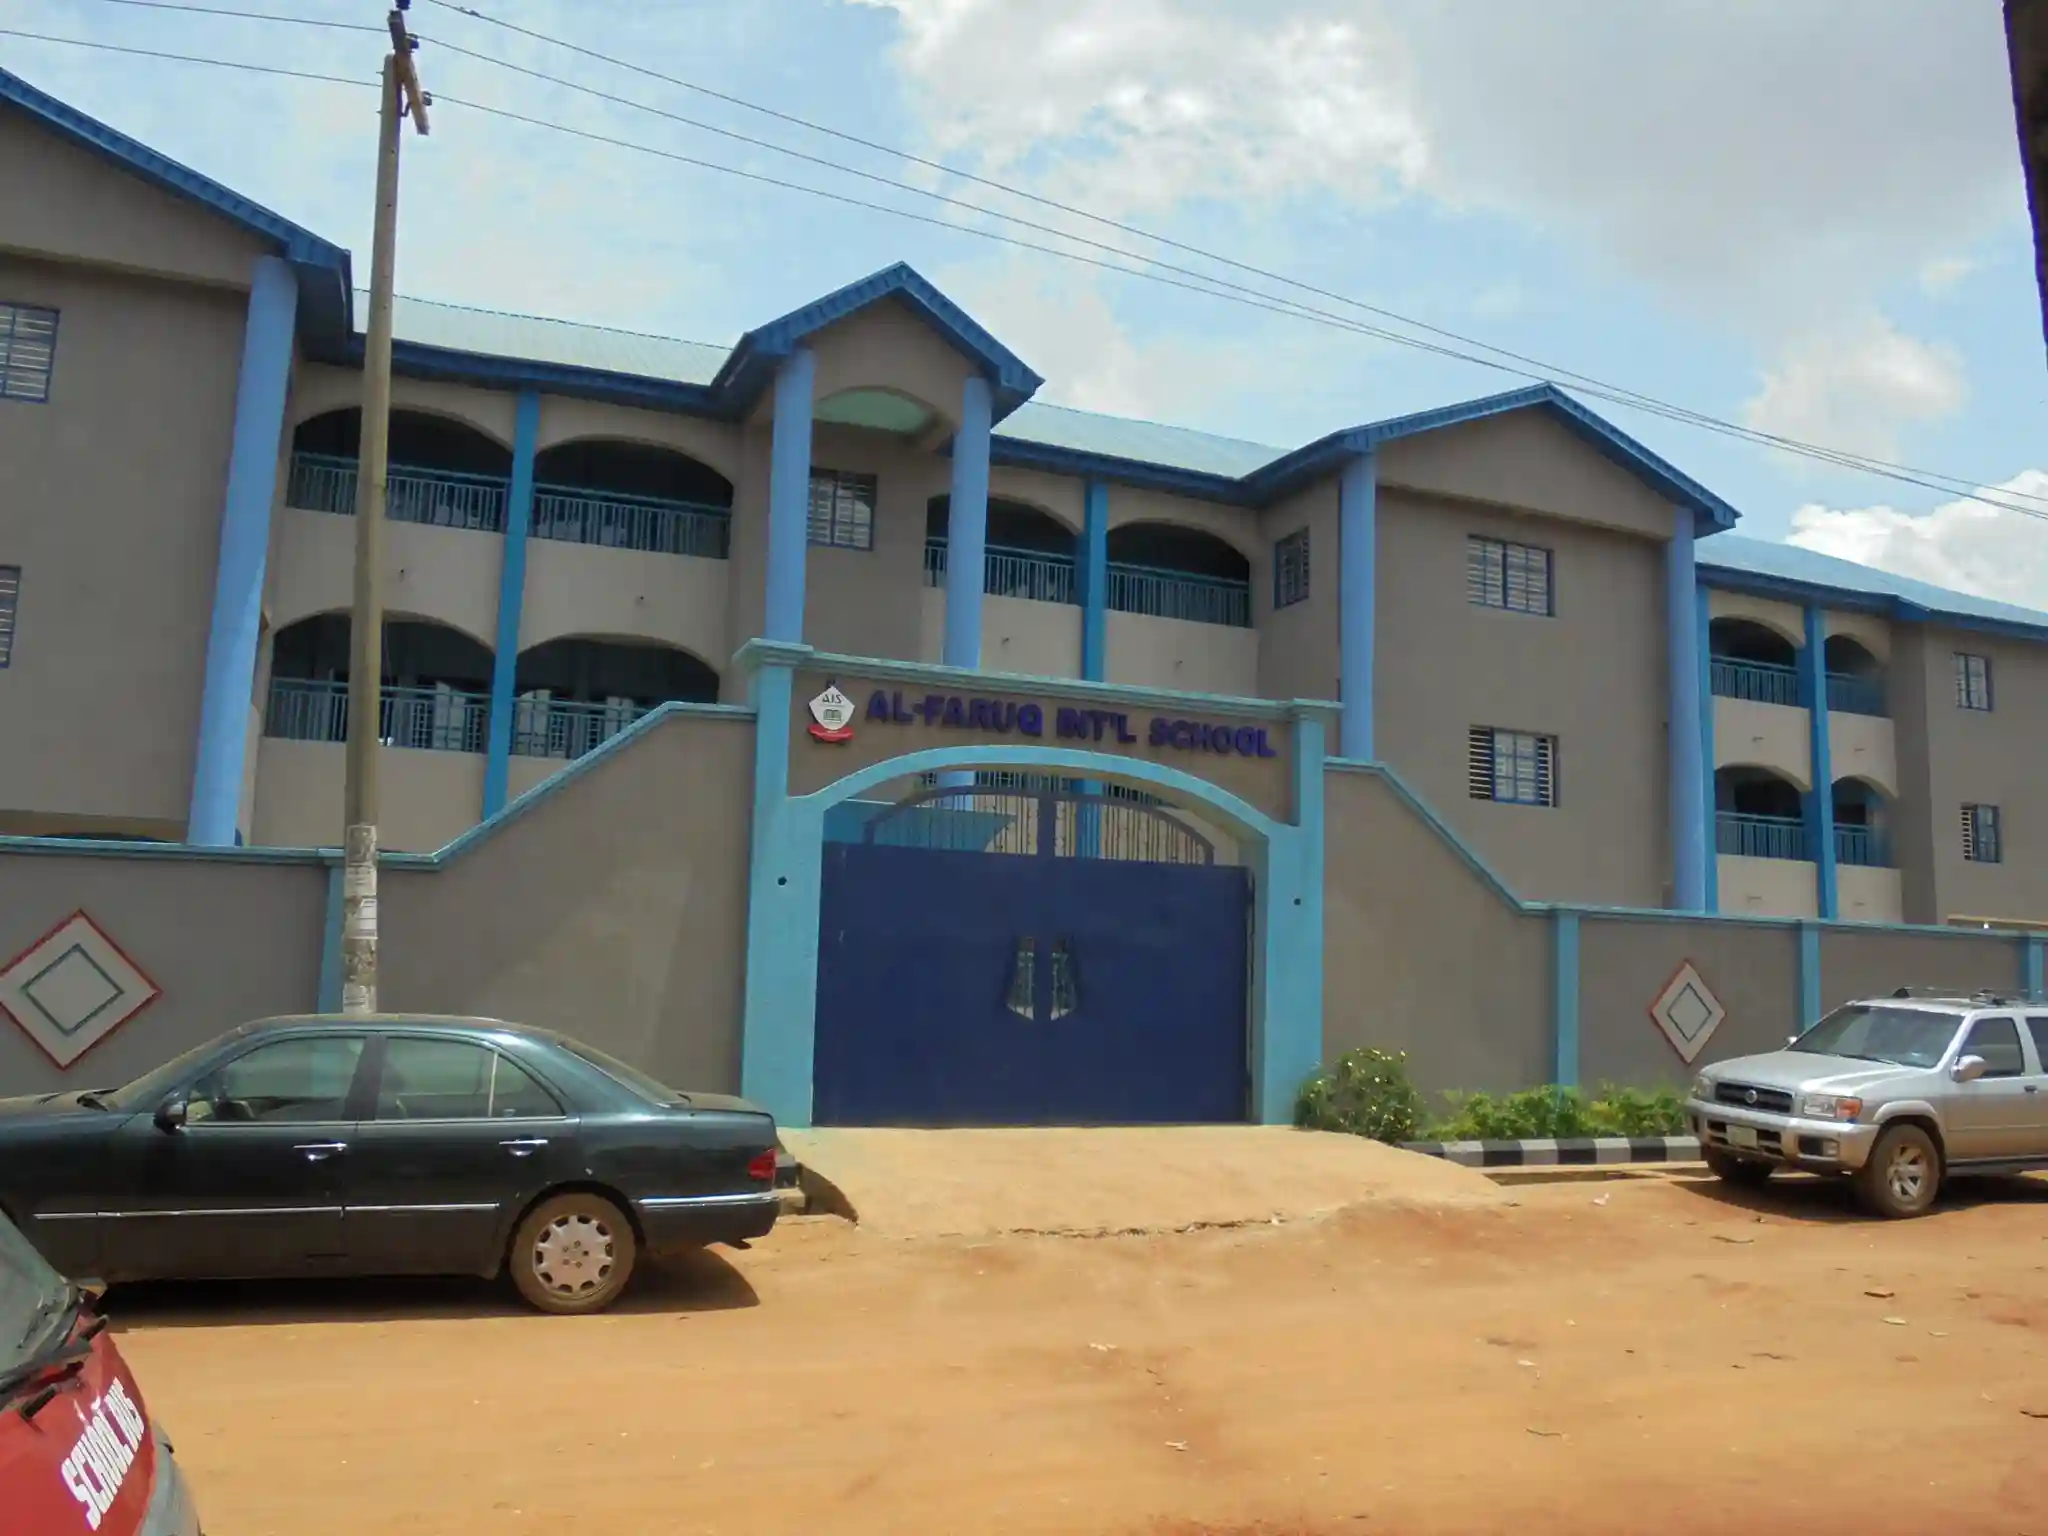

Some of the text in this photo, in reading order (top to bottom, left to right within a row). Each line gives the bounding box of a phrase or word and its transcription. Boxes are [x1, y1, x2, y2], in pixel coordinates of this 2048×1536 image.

[866, 689, 1277, 758] AL-FARUQ INT'L SCHOOL
[61, 1376, 145, 1531] SCHOOL BUS
